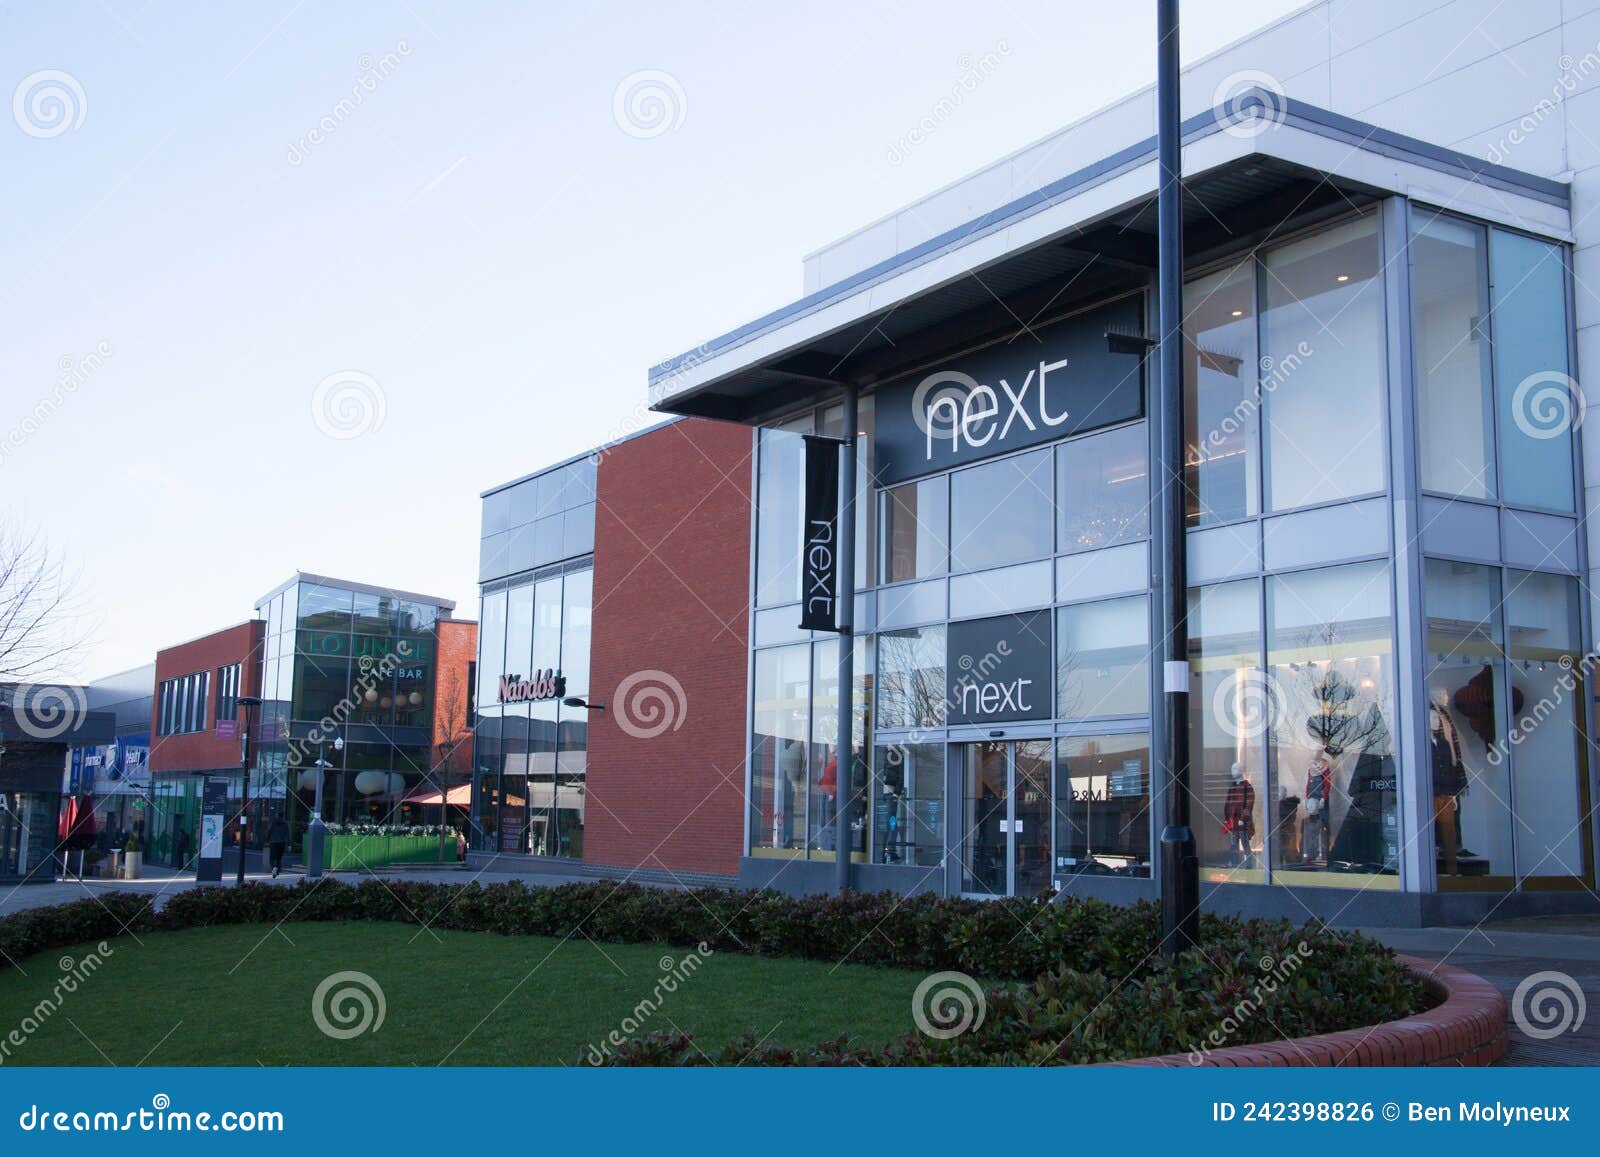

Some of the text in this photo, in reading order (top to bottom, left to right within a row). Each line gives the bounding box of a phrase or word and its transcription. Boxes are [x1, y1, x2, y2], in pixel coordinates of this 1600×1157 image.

[927, 359, 1069, 460] next
[809, 519, 832, 615] next
[310, 632, 428, 661] LOUNGE
[398, 668, 423, 680] BAR
[496, 668, 557, 703] Nando's
[962, 678, 1032, 715] next
